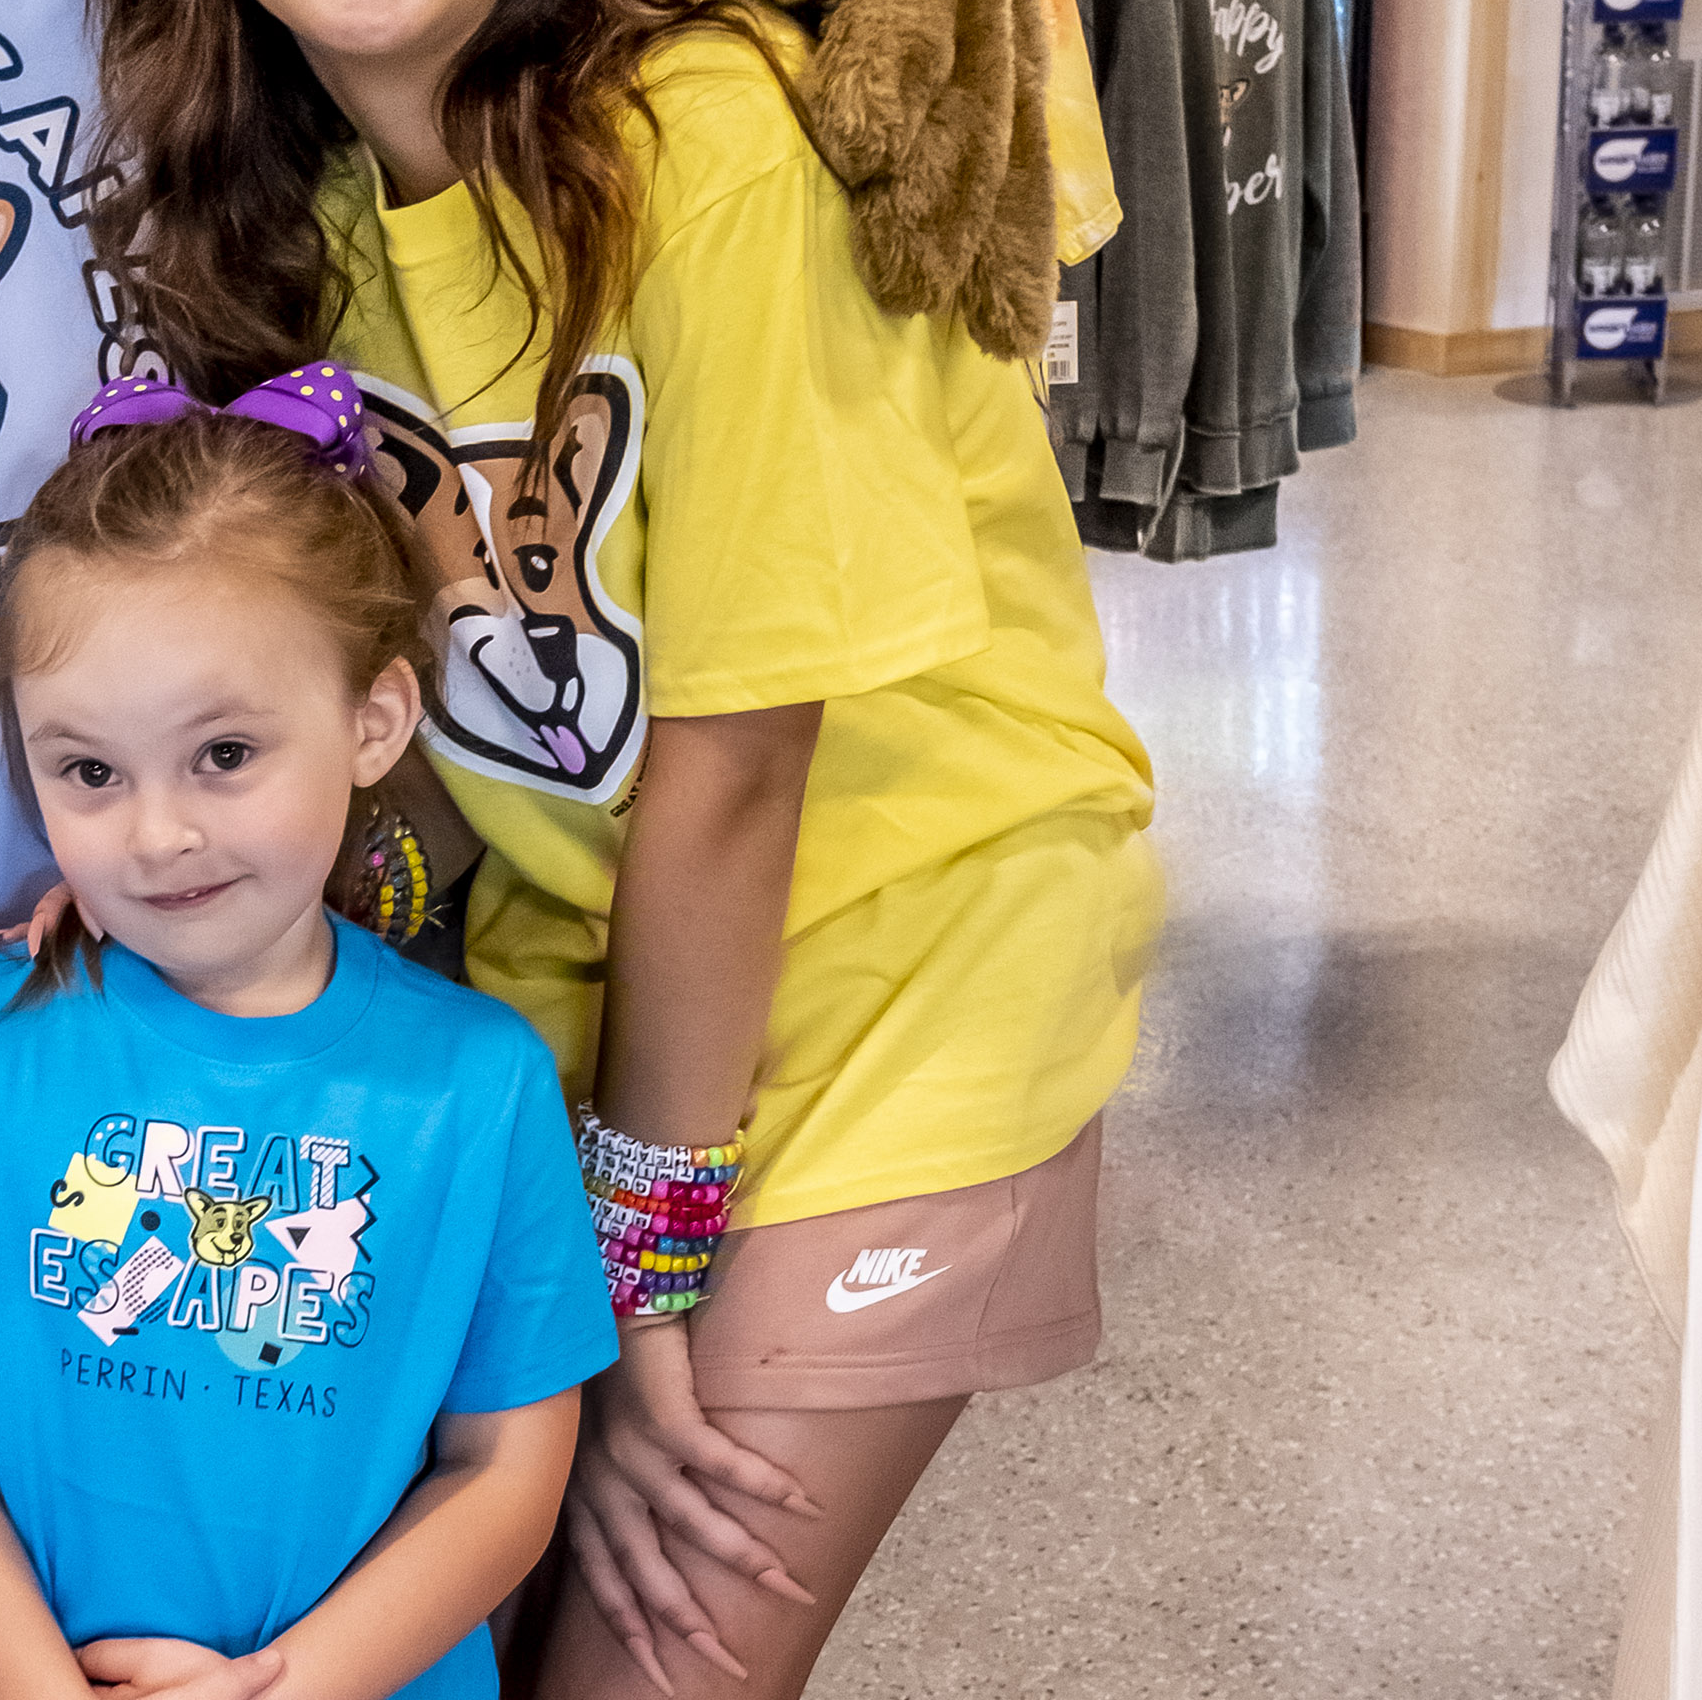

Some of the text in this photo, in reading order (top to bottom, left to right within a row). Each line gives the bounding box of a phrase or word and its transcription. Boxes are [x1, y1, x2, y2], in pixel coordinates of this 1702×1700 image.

[84, 1112, 349, 1214] GREAT
[30, 1228, 376, 1348] ESCAPES
[845, 1248, 928, 1285] NIKE
[60, 1348, 337, 1417] PERRIN TEXAS
